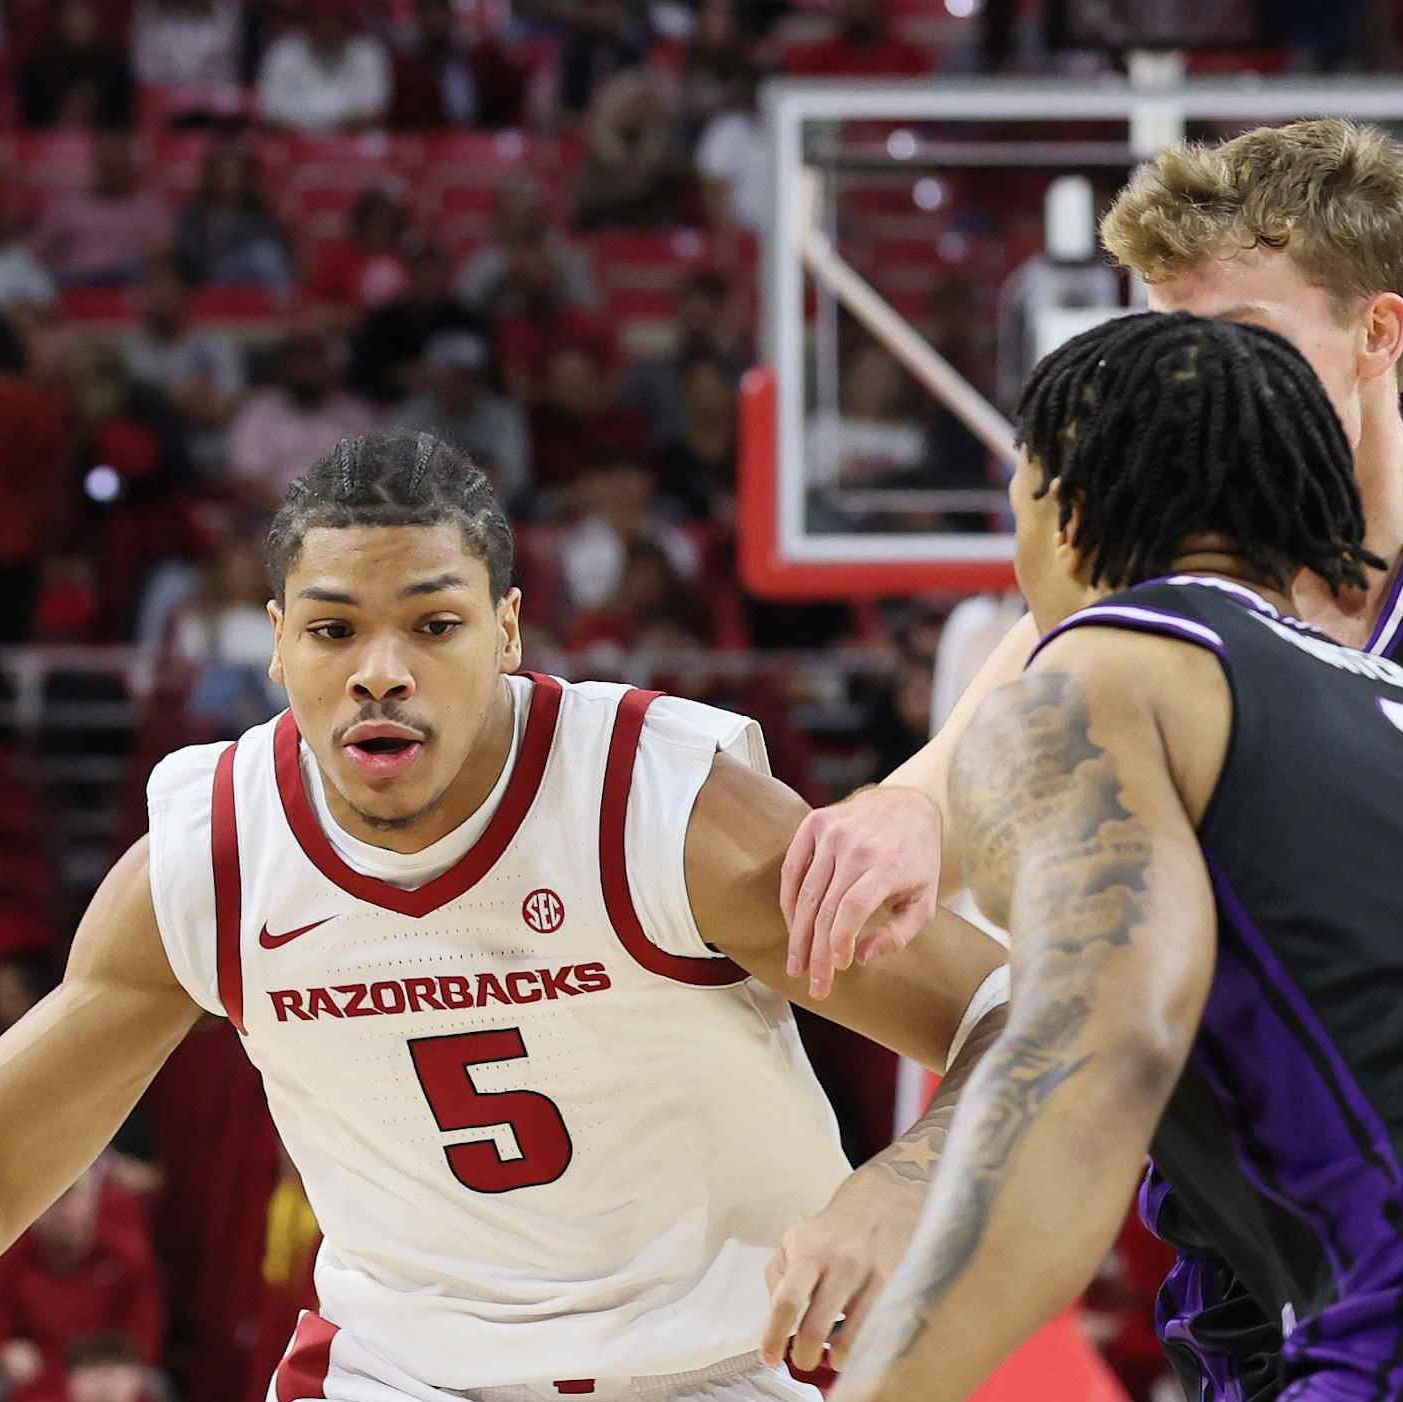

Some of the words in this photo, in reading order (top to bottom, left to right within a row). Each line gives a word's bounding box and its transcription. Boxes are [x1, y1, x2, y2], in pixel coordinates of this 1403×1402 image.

[524, 891, 563, 932] SEC
[266, 962, 612, 1022] RAZORBACKS
[406, 1027, 573, 1194] 5
